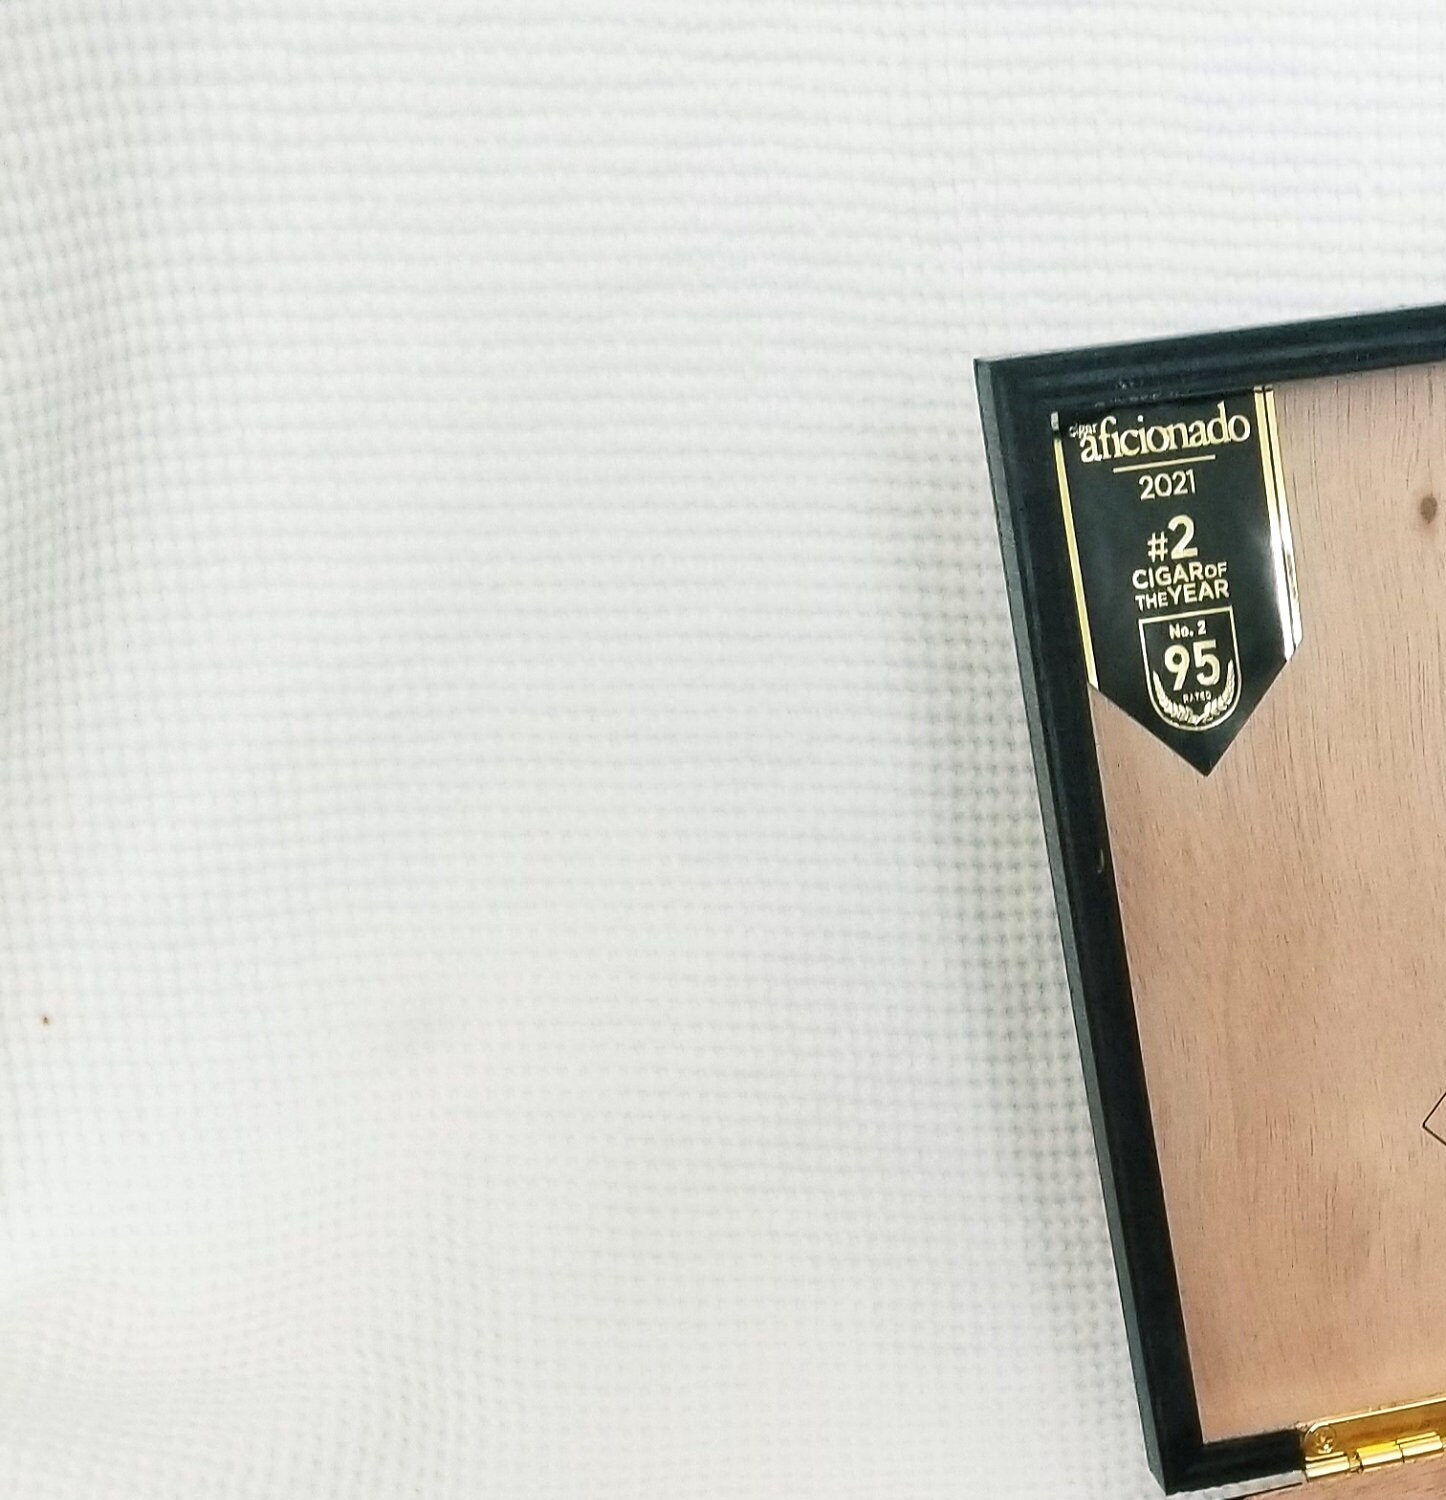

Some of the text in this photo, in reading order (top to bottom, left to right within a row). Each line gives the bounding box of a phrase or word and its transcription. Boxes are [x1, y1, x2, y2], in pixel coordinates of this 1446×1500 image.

[1079, 400, 1251, 463] aficionado
[1138, 468, 1196, 501] 2021
[1146, 514, 1199, 563] #2
[1131, 561, 1228, 590] CIGAR OF
[1134, 578, 1230, 612] THE YEAR
[1168, 619, 1207, 640] No. 2
[1164, 639, 1221, 692] 95
